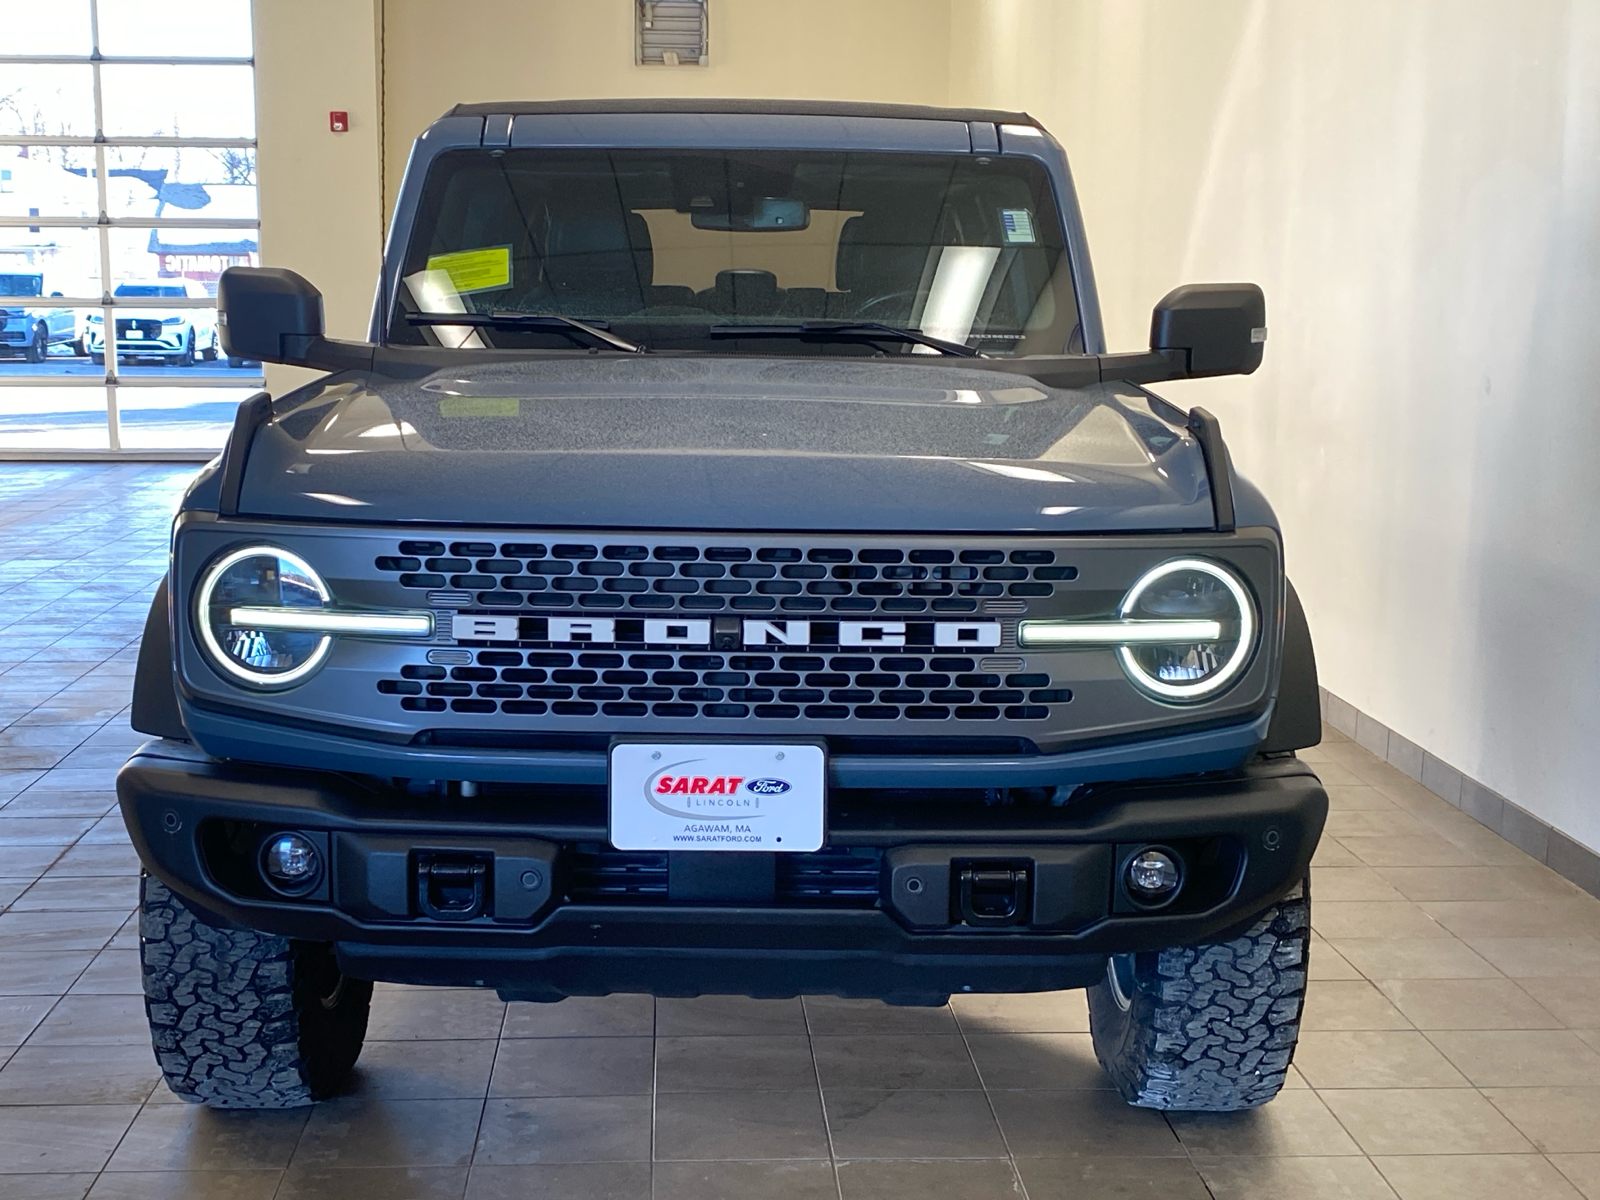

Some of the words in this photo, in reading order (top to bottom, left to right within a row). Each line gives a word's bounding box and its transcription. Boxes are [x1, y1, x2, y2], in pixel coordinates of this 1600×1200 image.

[452, 614, 1001, 648] BRONCO
[655, 775, 744, 795] SARAT
[753, 780, 784, 793] Ford
[696, 798, 751, 807] LINCOLN
[683, 824, 733, 834] AGAWAM,
[735, 824, 751, 833] MA
